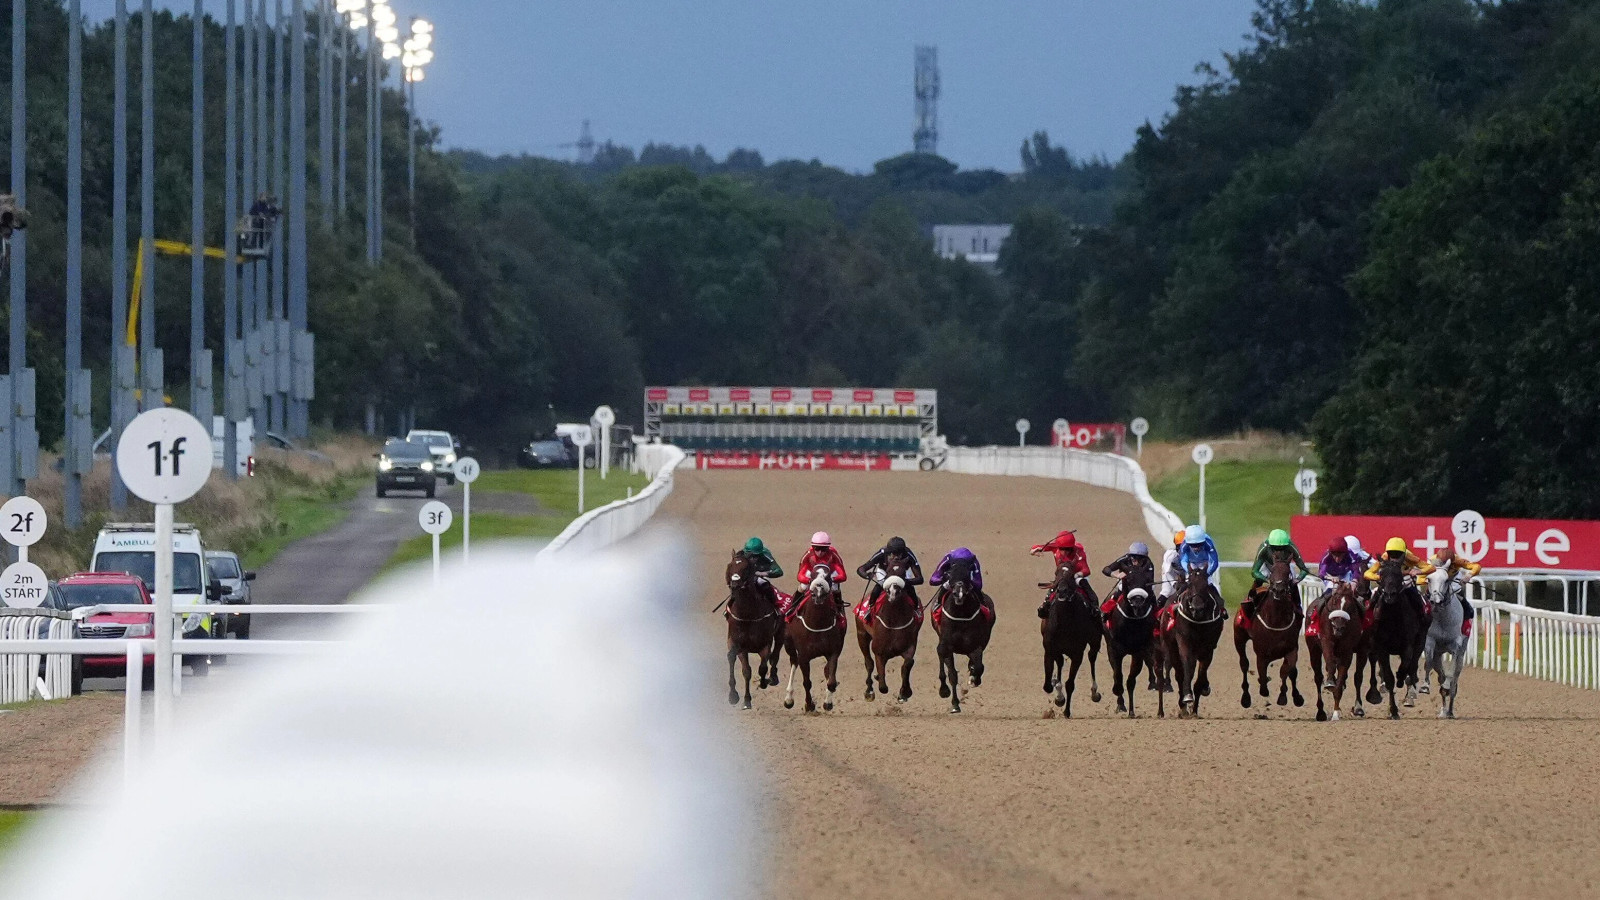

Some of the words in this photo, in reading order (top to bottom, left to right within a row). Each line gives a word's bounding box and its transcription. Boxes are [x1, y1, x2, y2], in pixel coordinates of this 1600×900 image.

[147, 436, 187, 476] 1f
[461, 463, 472, 477] 4f
[10, 511, 34, 533] 2f
[427, 512, 444, 525] 3f
[1460, 520, 1477, 534] 3f
[116, 540, 181, 548] AMBULE
[14, 574, 33, 584] 2m
[4, 588, 42, 598] START
